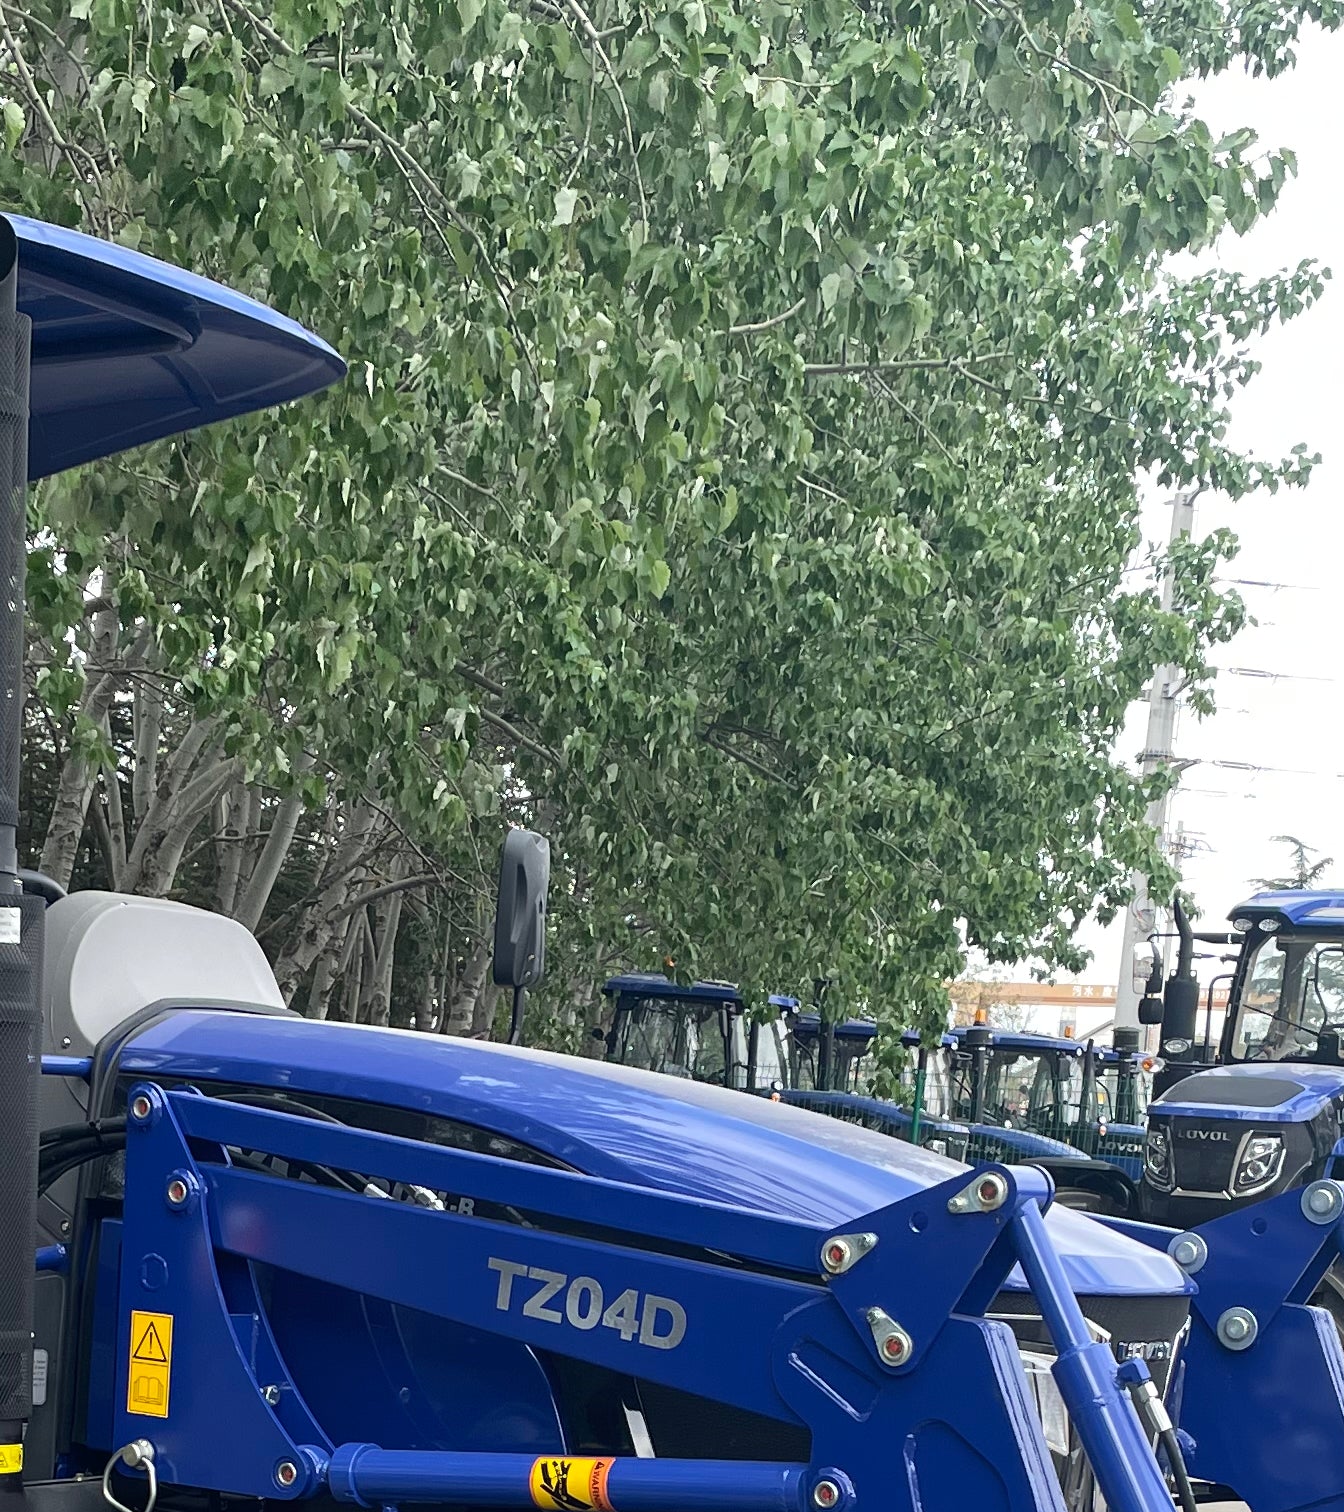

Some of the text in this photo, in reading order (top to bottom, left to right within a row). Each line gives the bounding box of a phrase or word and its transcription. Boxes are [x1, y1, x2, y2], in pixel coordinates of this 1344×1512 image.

[1178, 1129, 1232, 1142] LOVOL
[1098, 1140, 1144, 1154] LOVOL
[488, 1256, 687, 1350] TZ04D
